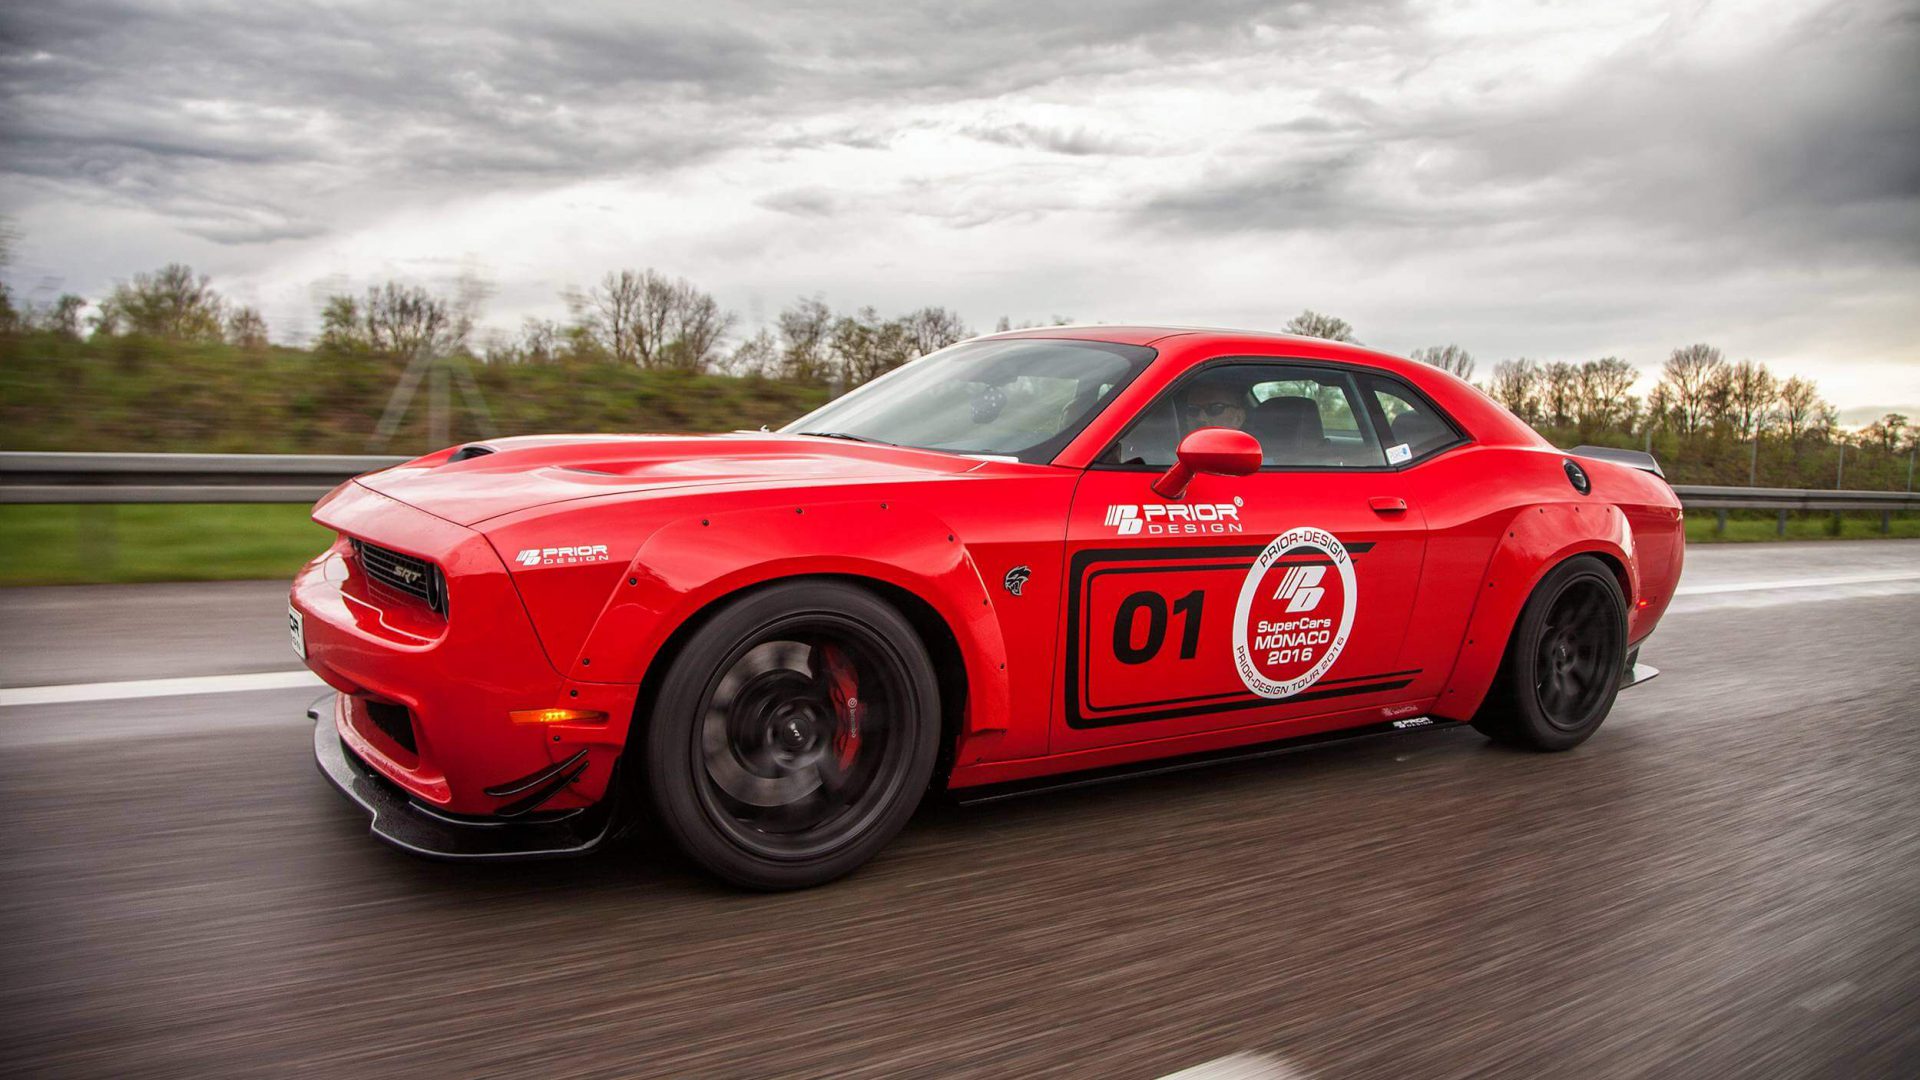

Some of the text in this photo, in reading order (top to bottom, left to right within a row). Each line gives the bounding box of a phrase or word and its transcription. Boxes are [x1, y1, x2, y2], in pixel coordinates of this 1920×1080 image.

[1143, 503, 1239, 521] PRIOR
[1148, 523, 1243, 534] DESIGN
[543, 545, 608, 558] PRIOR
[1259, 530, 1346, 568] PRIOR-DESIGN
[543, 555, 609, 565] DESIGN
[393, 565, 422, 584] SRT
[1113, 590, 1204, 664] 01
[1257, 617, 1332, 634] SuperCars
[1254, 630, 1331, 650] MONACO
[1236, 636, 1346, 695] PRIOR-DESIGN TOUR 2016
[1267, 647, 1314, 666] 2016
